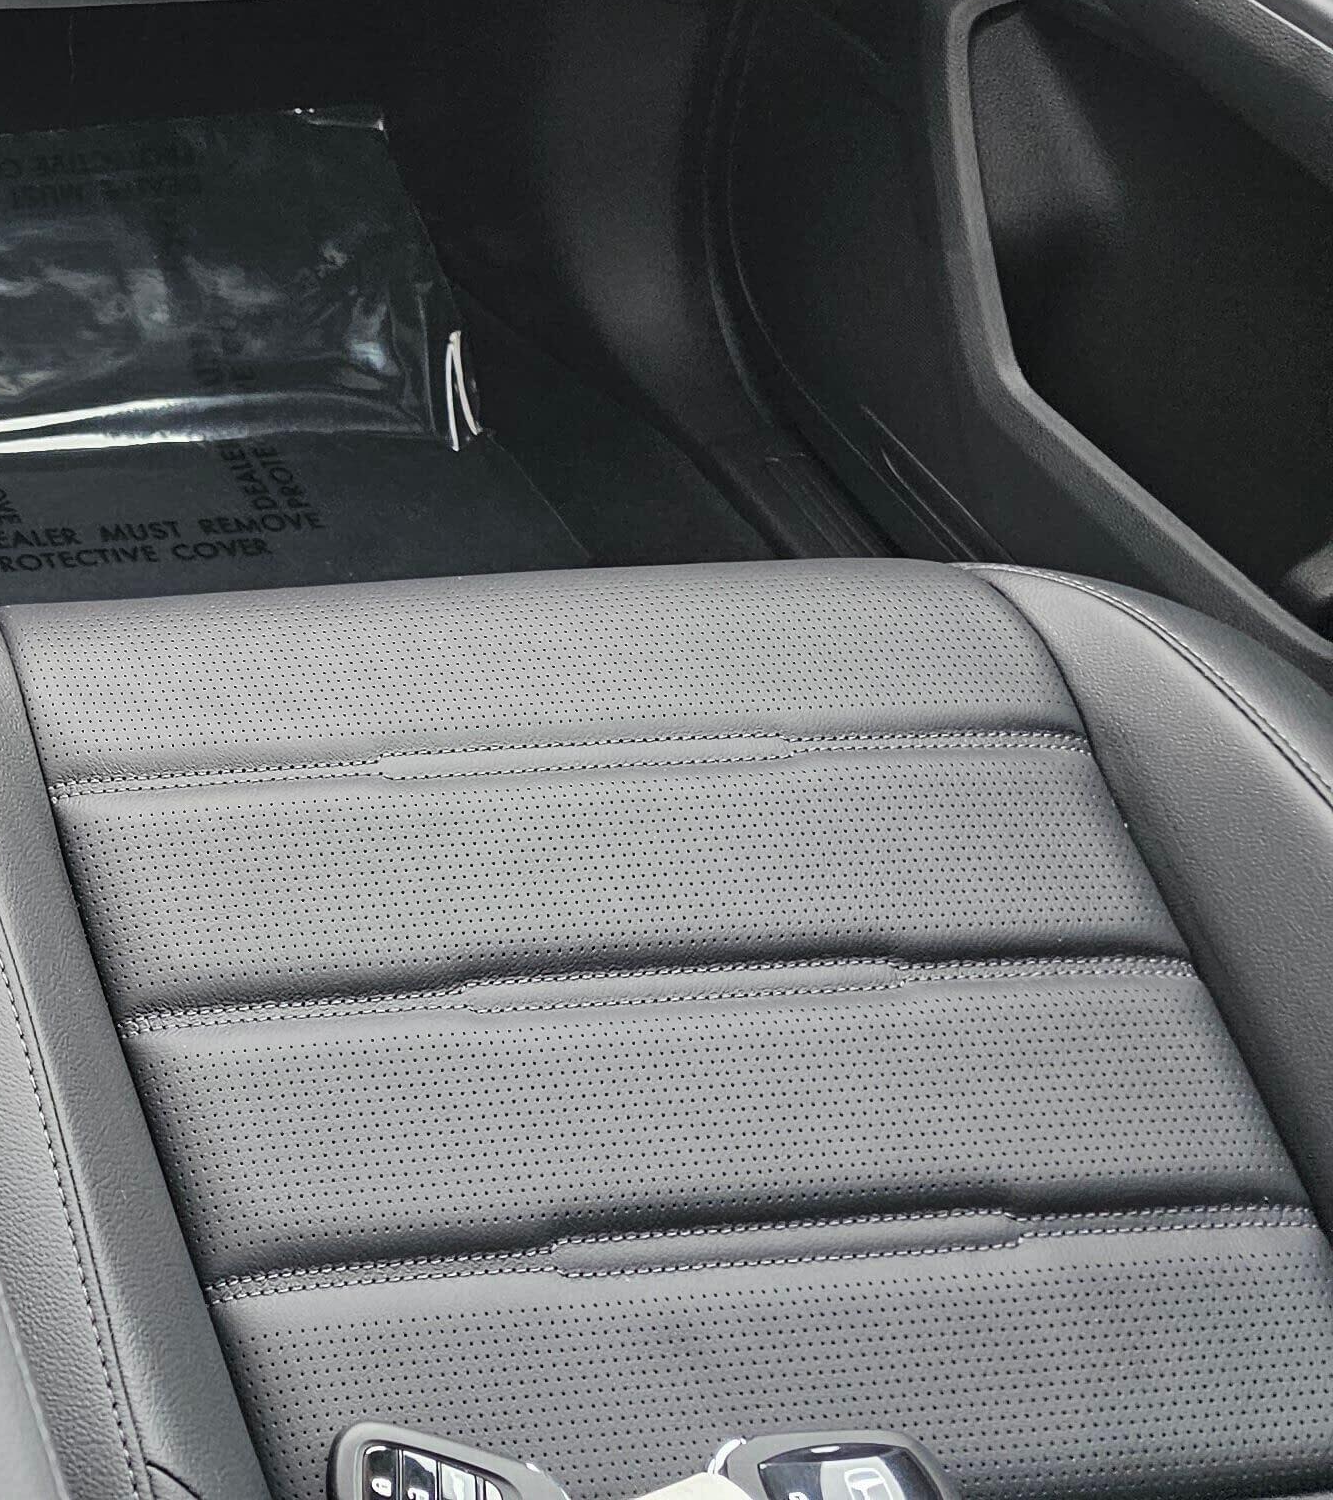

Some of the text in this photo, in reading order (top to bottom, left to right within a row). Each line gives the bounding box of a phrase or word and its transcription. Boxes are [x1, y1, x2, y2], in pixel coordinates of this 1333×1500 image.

[216, 440, 277, 510] DEALE
[99, 520, 181, 543] MUST
[198, 511, 326, 536] REMOVE
[172, 538, 273, 561] COVER
